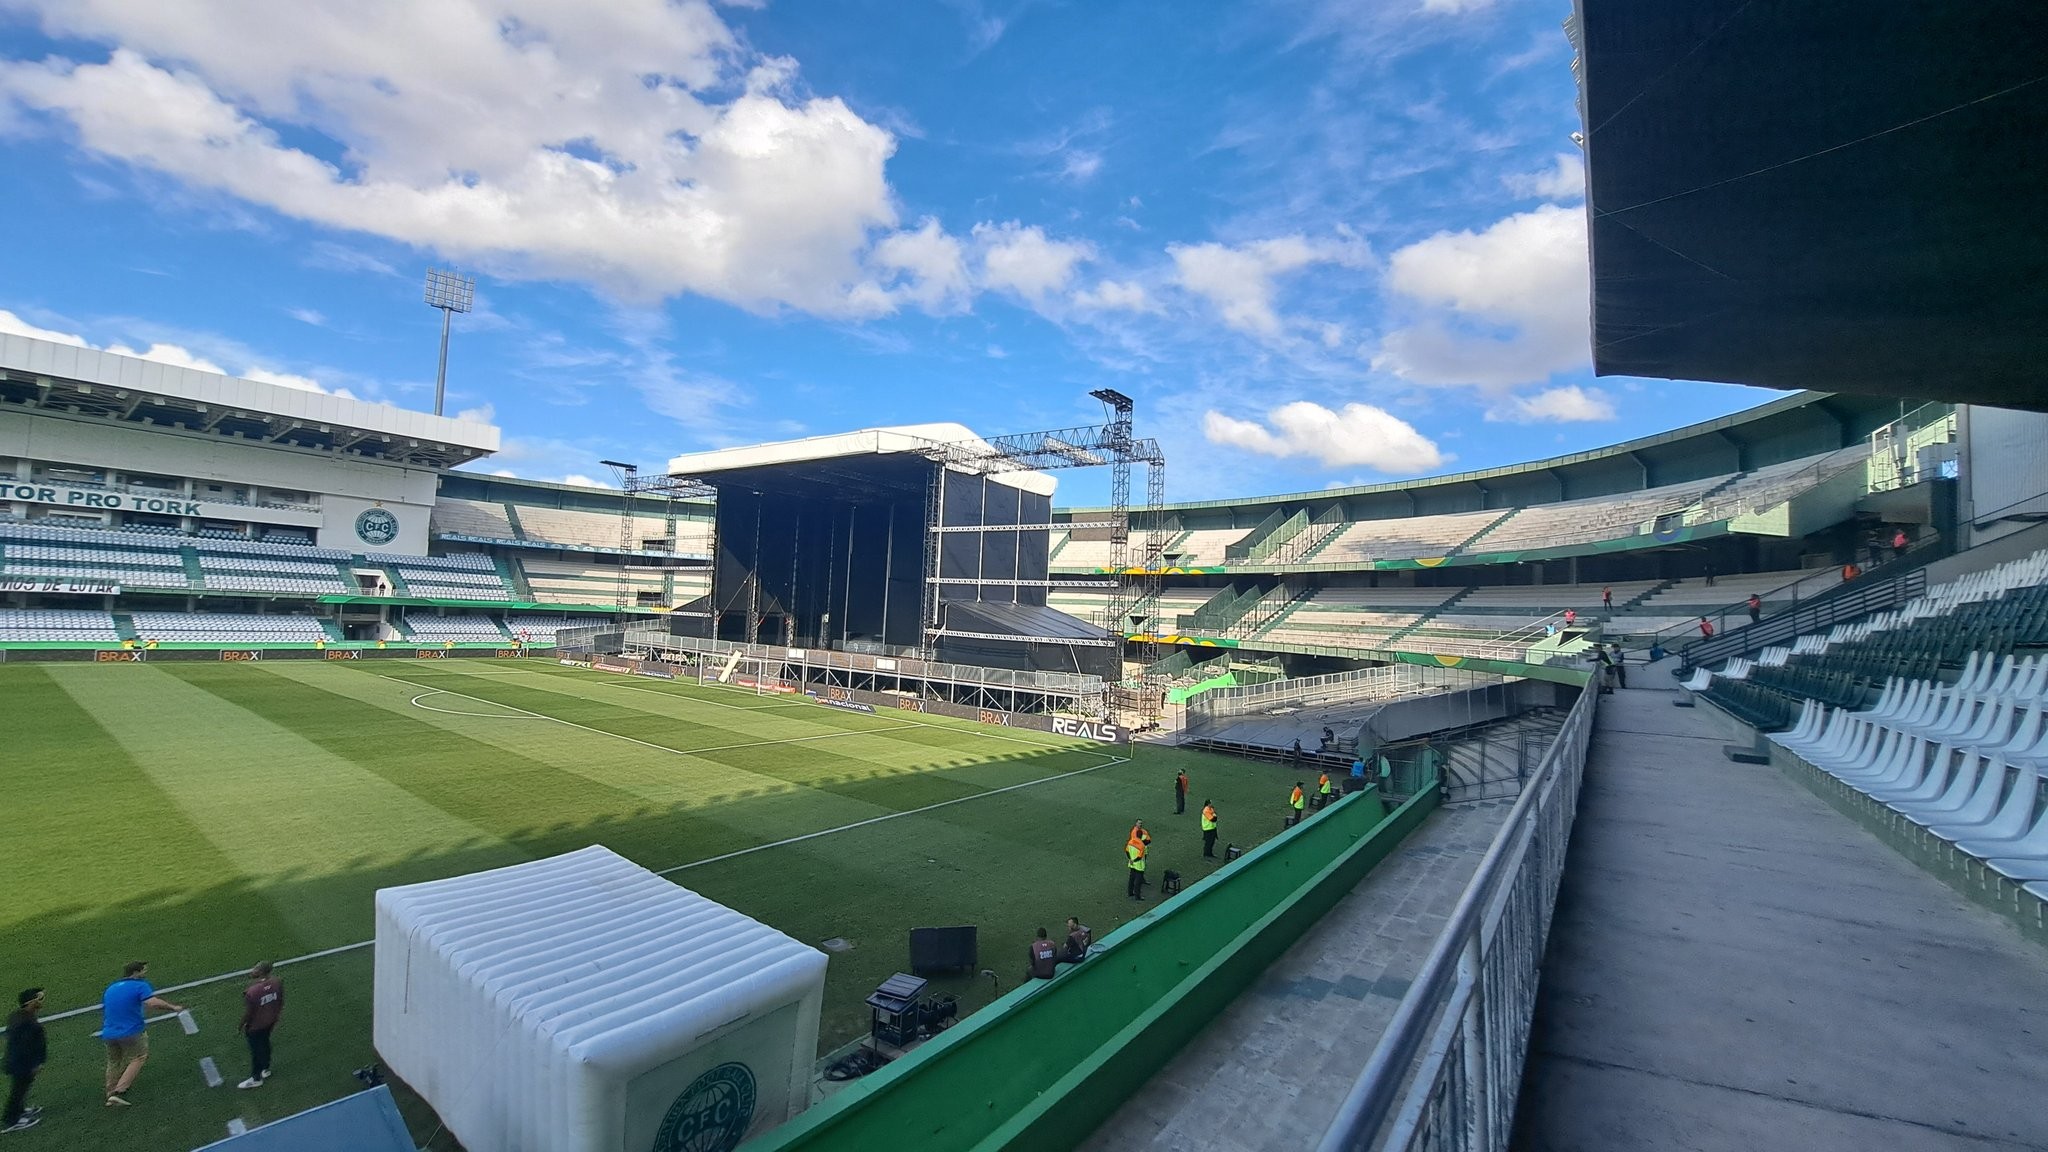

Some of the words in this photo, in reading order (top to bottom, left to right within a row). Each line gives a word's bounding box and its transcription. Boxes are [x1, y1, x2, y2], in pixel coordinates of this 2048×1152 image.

[0, 485, 56, 502] TOR
[67, 491, 121, 508] PRO
[131, 497, 202, 515] TORK
[42, 578, 64, 591] DE
[69, 579, 115, 593] LUTAR
[100, 651, 142, 662] BRAX
[223, 651, 259, 661] BRAX
[328, 650, 359, 660] BRAX
[418, 650, 445, 659] BRAX
[498, 650, 521, 658] BRAX
[830, 688, 852, 701] BRAX
[900, 699, 924, 713] BRAX
[980, 711, 1009, 726] BRAX
[1052, 717, 1117, 741] REALS
[678, 1098, 732, 1142] CFC
